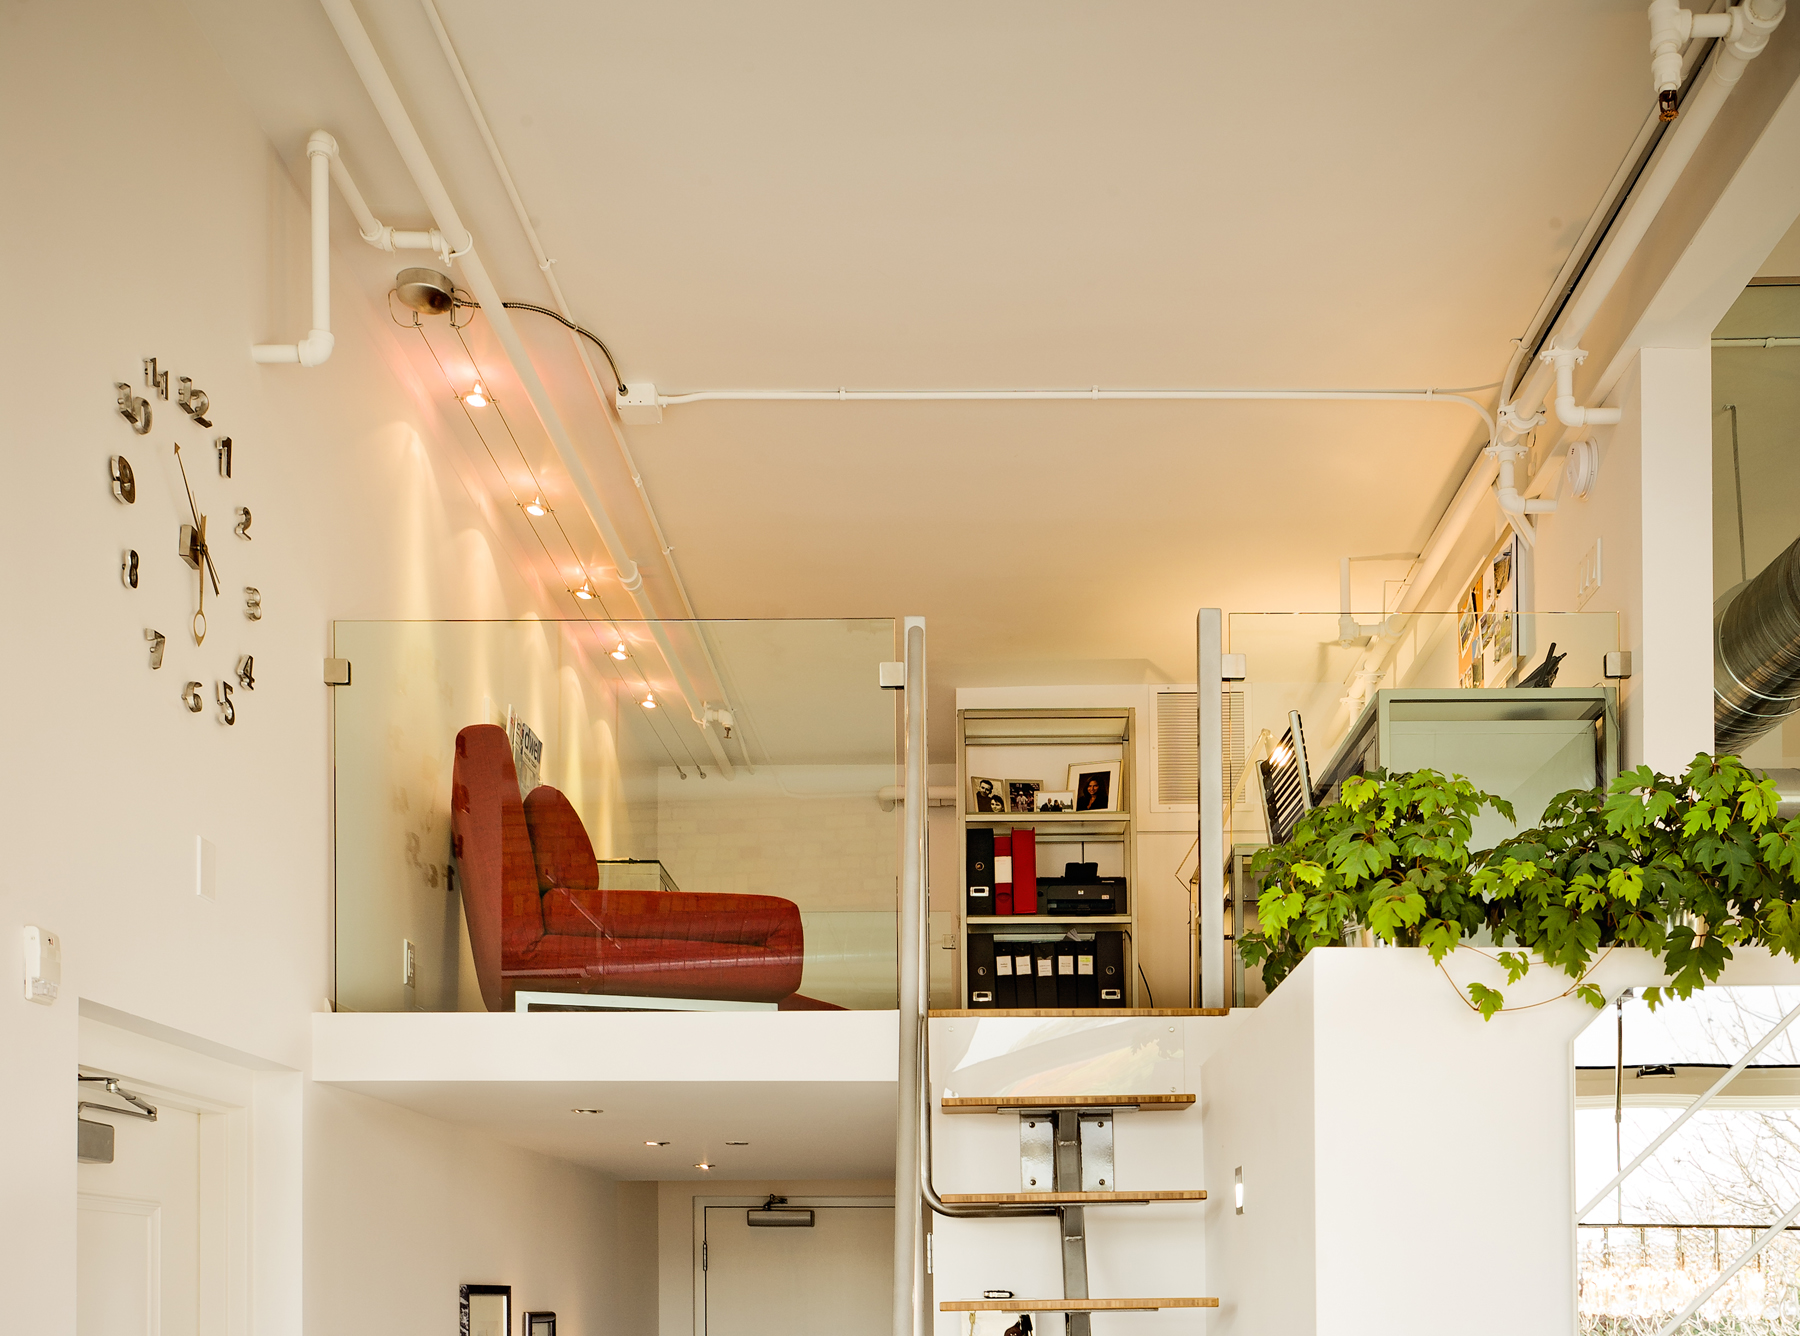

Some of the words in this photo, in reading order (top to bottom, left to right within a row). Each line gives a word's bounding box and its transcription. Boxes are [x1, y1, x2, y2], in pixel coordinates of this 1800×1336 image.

[116, 382, 153, 435] 10
[177, 376, 213, 428] 12
[215, 436, 232, 478] 1
[110, 455, 136, 504] 9
[235, 507, 252, 541] 2
[122, 550, 139, 589] 8
[245, 586, 262, 621] 3
[145, 628, 166, 670] 7
[236, 655, 255, 691] 4
[181, 681, 203, 713] 6
[216, 680, 235, 726] 5
